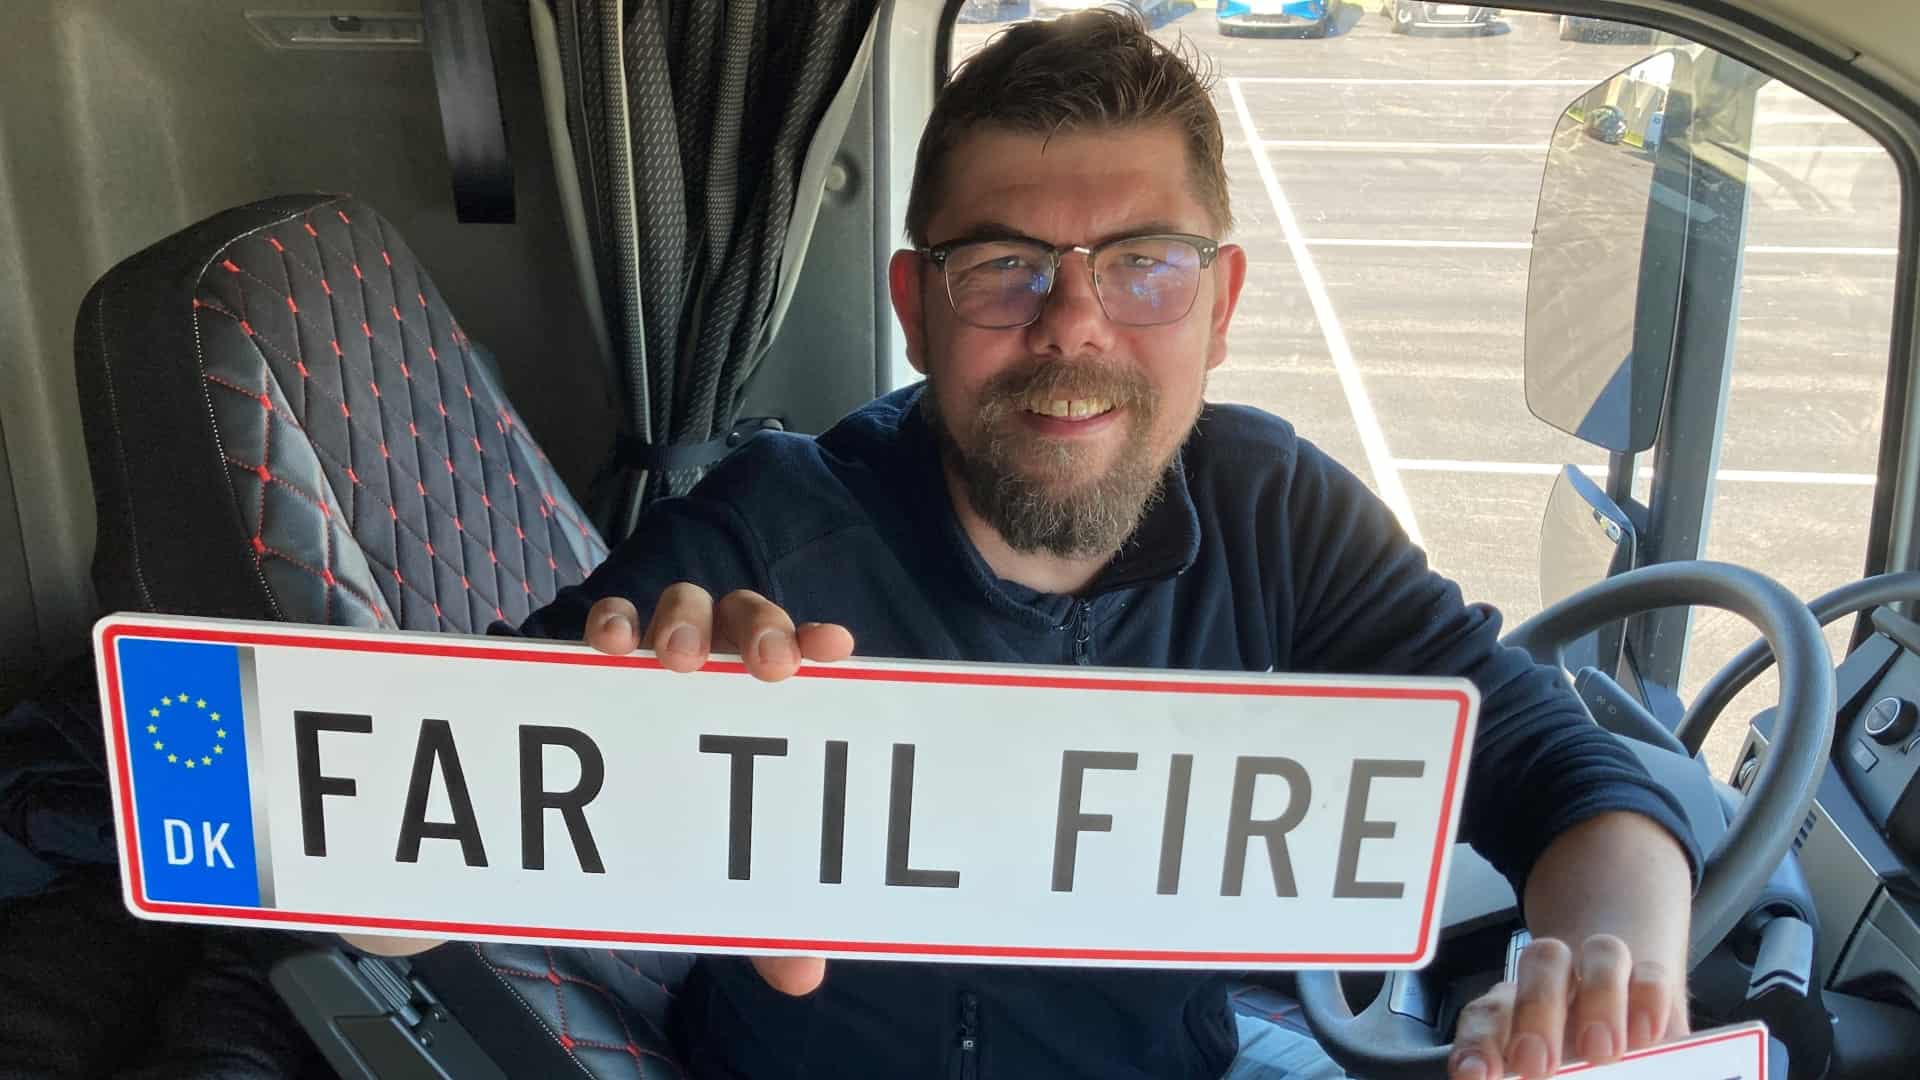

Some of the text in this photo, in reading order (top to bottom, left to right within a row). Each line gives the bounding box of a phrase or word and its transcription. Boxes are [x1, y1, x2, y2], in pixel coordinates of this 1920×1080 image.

[163, 819, 235, 869] DK
[293, 709, 1426, 899] FAR TIL FIRE
